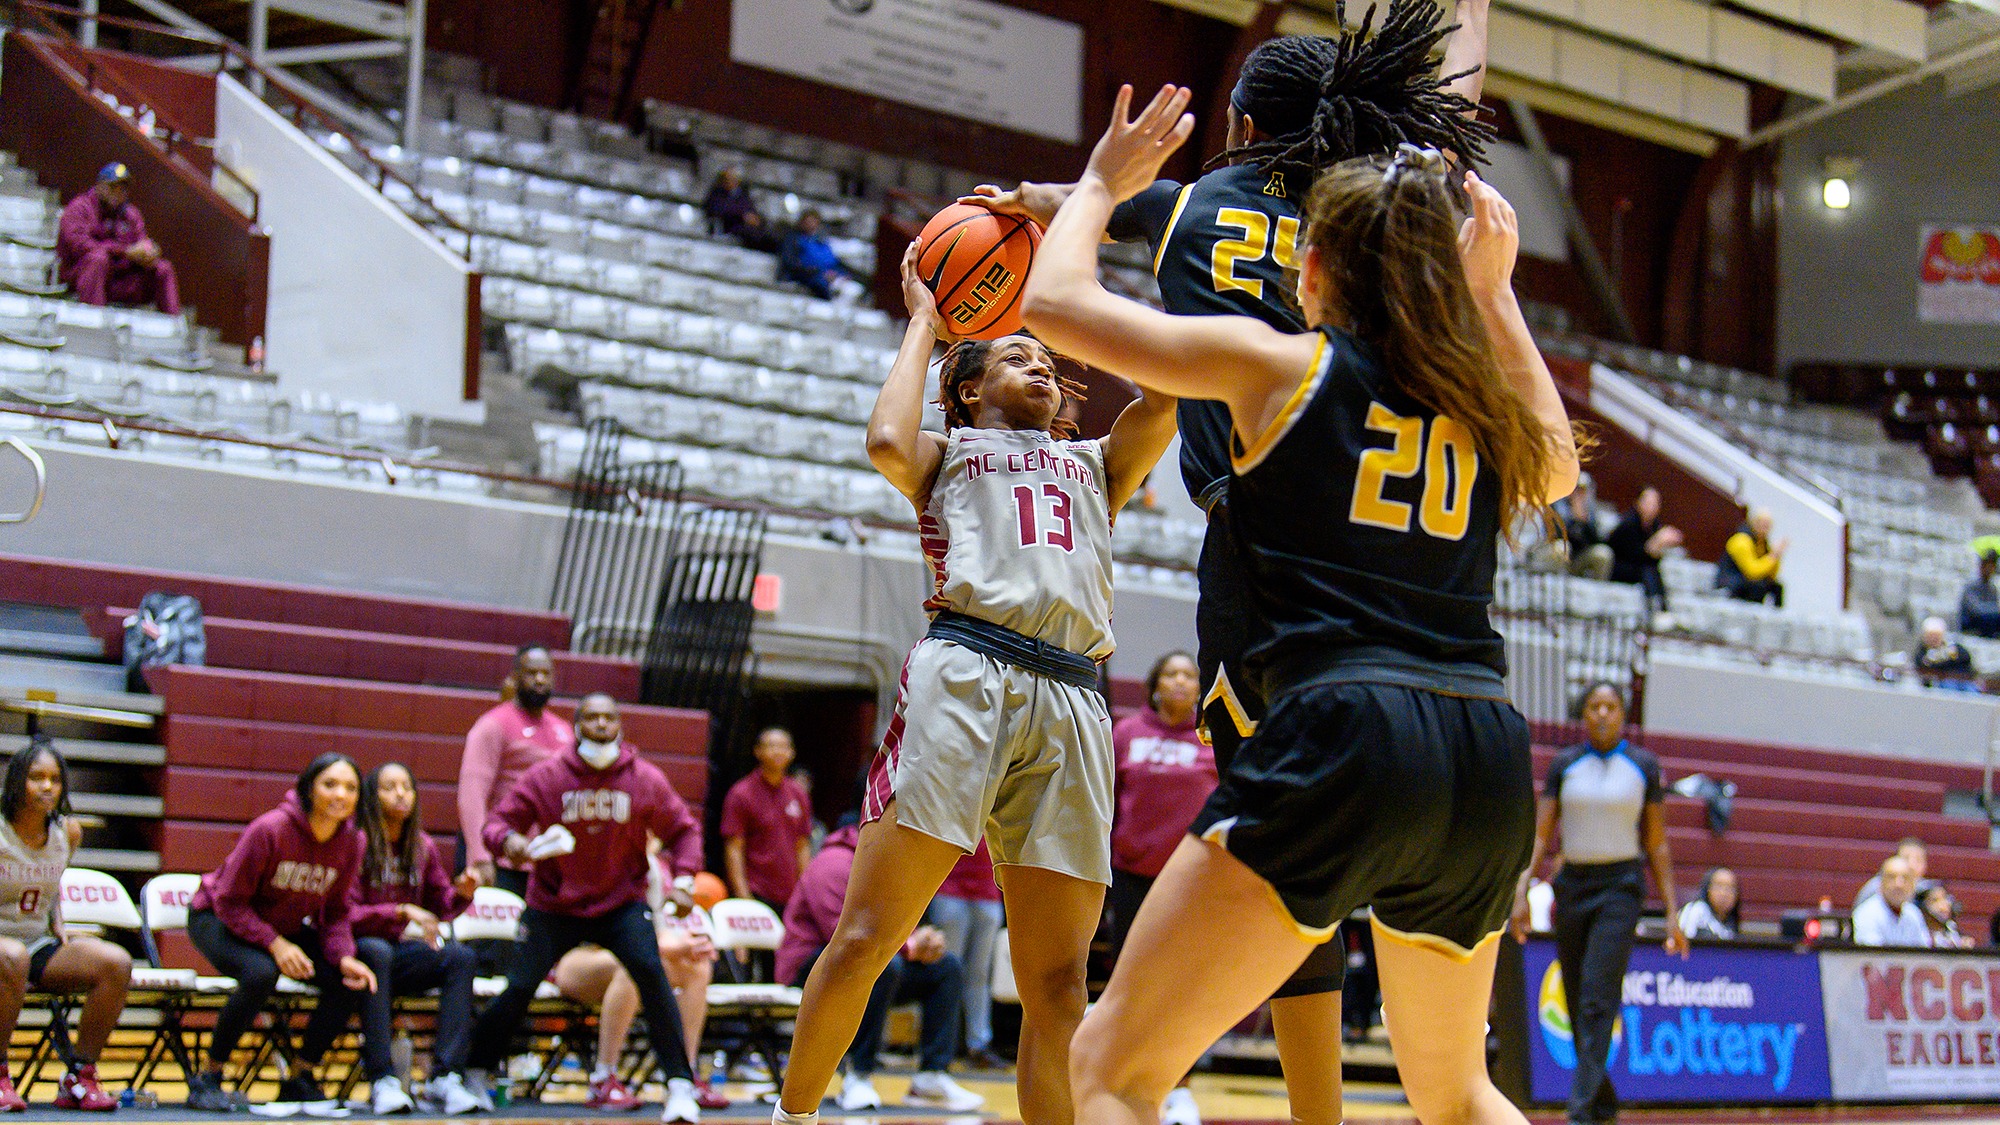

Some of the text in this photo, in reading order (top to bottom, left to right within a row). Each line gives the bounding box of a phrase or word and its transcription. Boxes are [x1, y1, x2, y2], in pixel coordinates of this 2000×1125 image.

[1263, 171, 1287, 198] A
[948, 261, 1011, 325] ELITE
[965, 273, 1016, 329] CHAMPIONSHIP
[964, 448, 1100, 496] NC CENTRAL
[1348, 401, 1479, 541] 20
[1011, 482, 1077, 555] 13
[59, 885, 118, 902] CCU
[1656, 971, 1754, 1009] Education
[1622, 1005, 1798, 1094] Lottery
[1886, 1031, 2000, 1066] EAGLE
